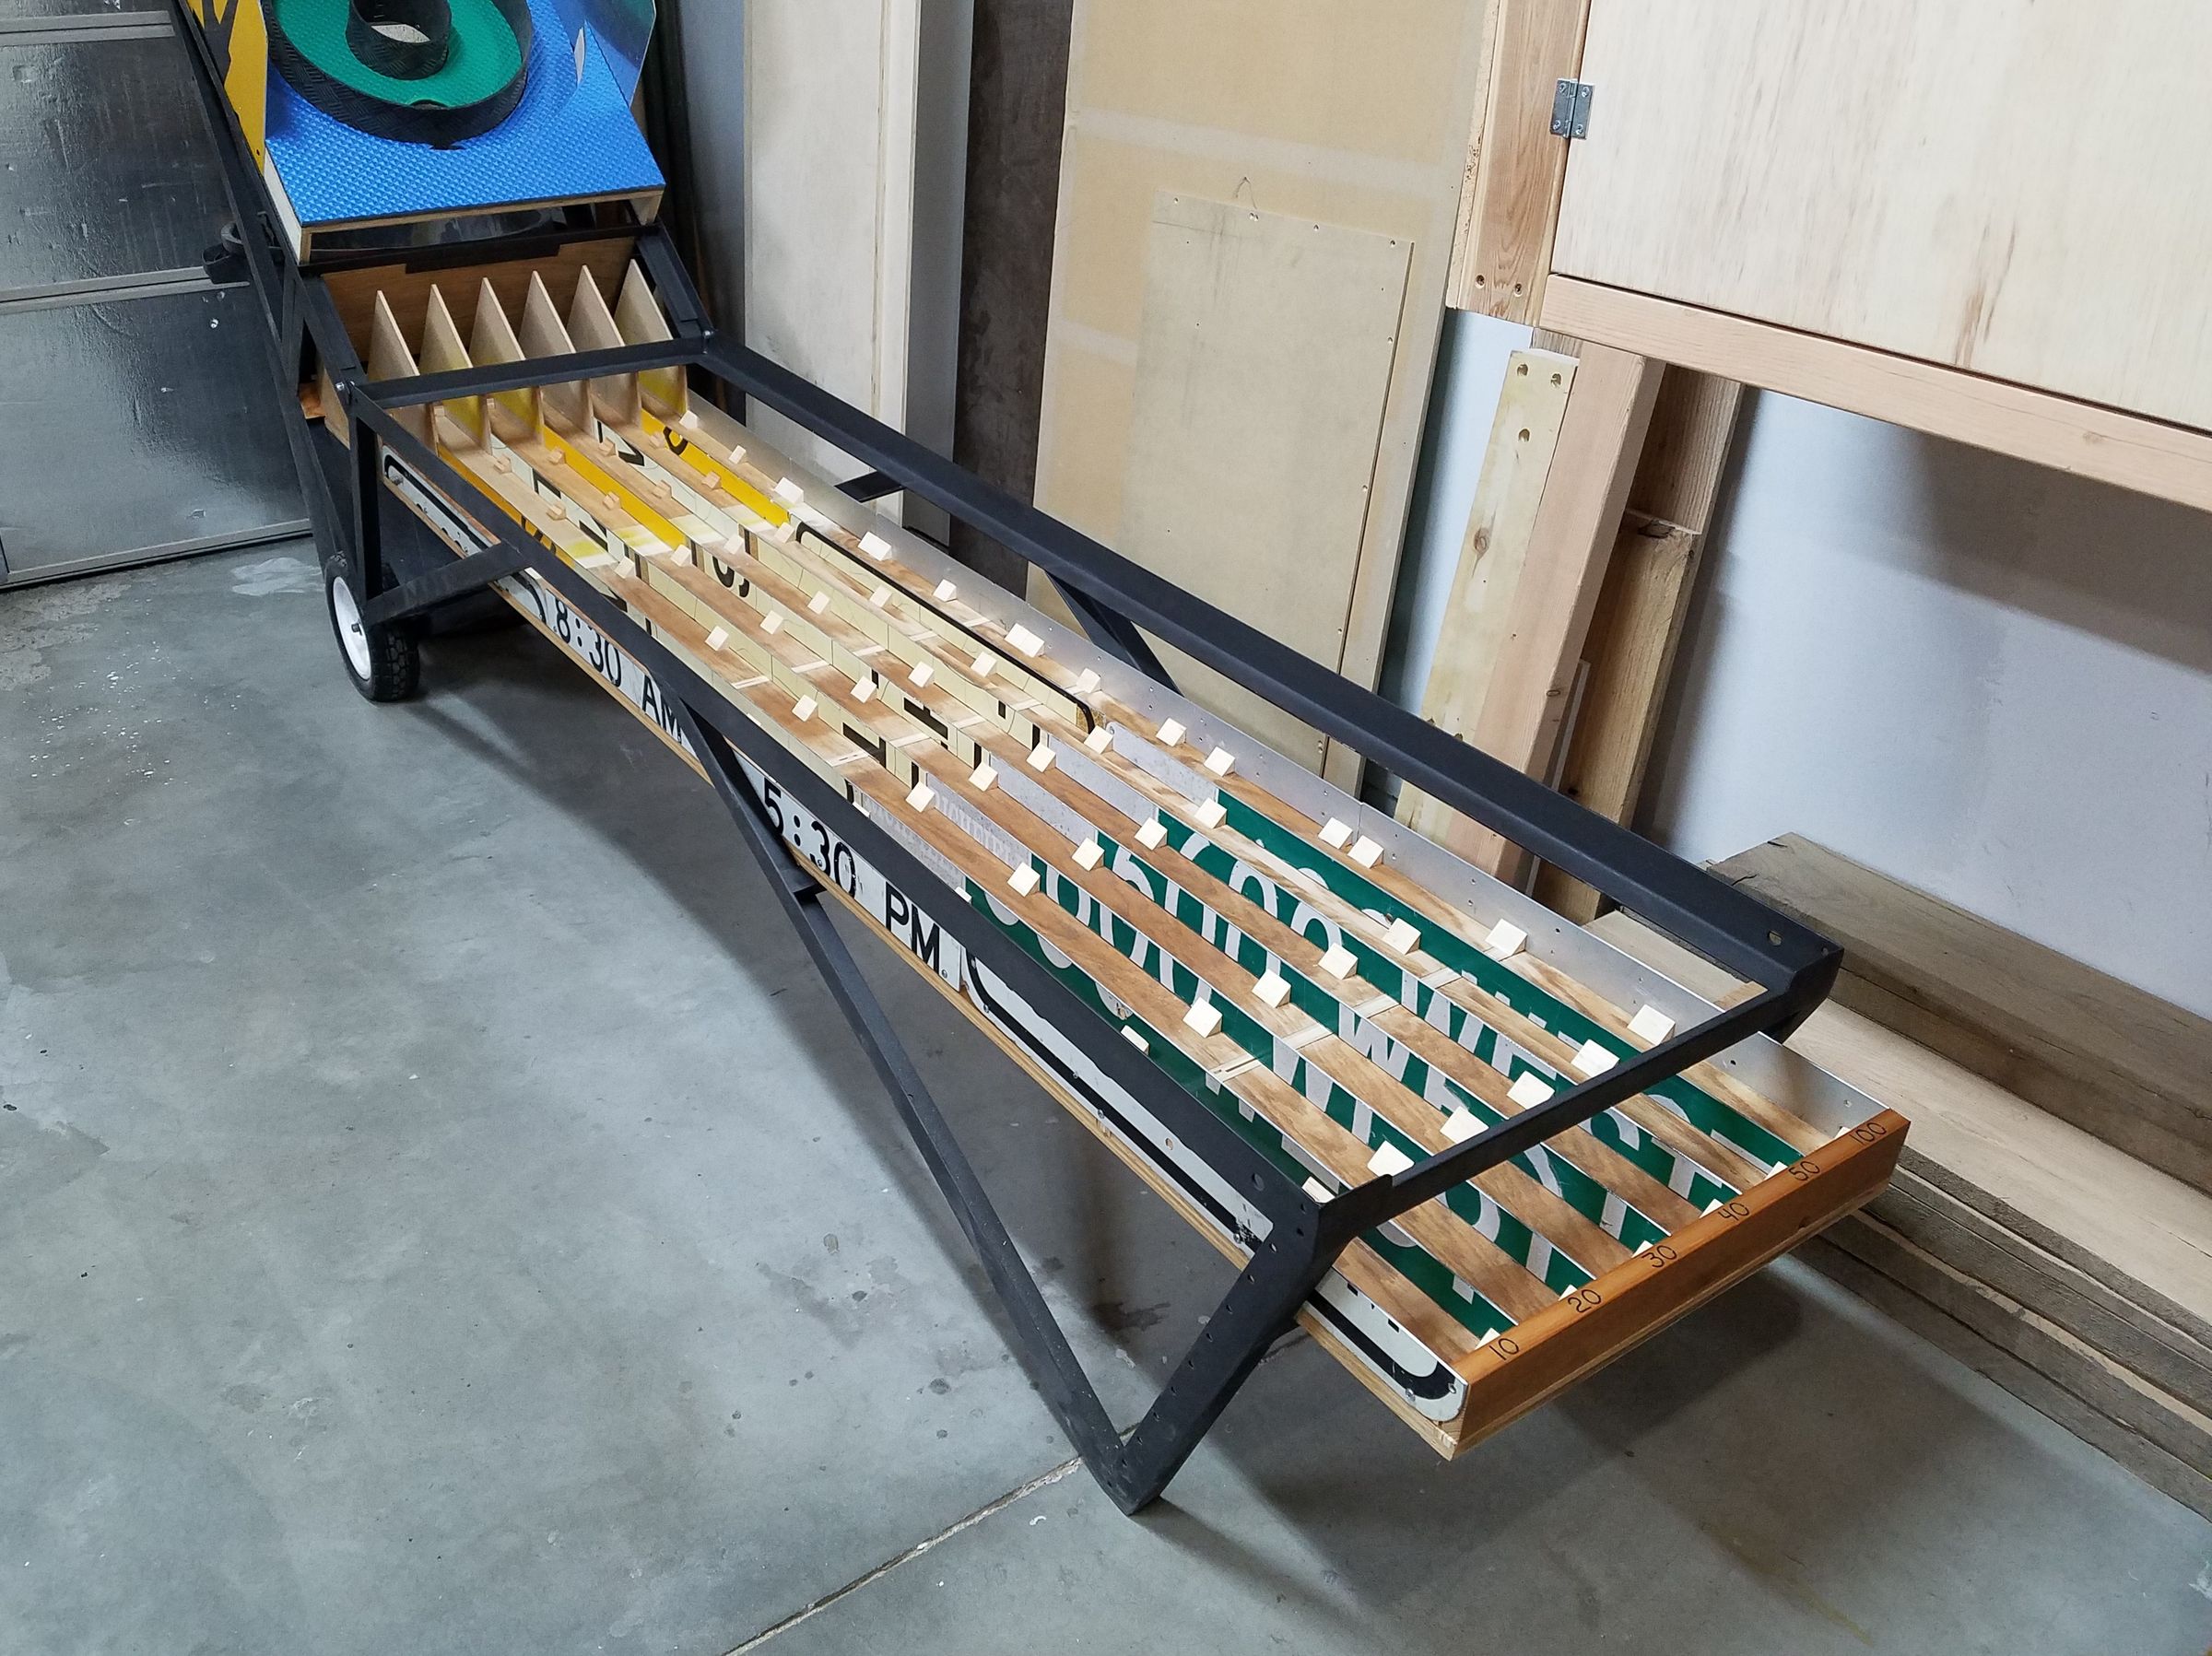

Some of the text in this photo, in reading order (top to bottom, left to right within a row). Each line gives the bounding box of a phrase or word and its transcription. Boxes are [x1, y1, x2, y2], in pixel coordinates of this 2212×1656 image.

[555, 598, 622, 687] 8:30
[641, 674, 683, 745] AM
[763, 777, 856, 899] 5:30
[885, 880, 940, 976] PM
[1849, 1122, 1887, 1145] 100
[1788, 1160, 1820, 1181] 50
[1717, 1202, 1749, 1221] 40
[1641, 1244, 1677, 1268] 30
[1567, 1288, 1602, 1313] 20
[1488, 1337, 1520, 1361] 10
